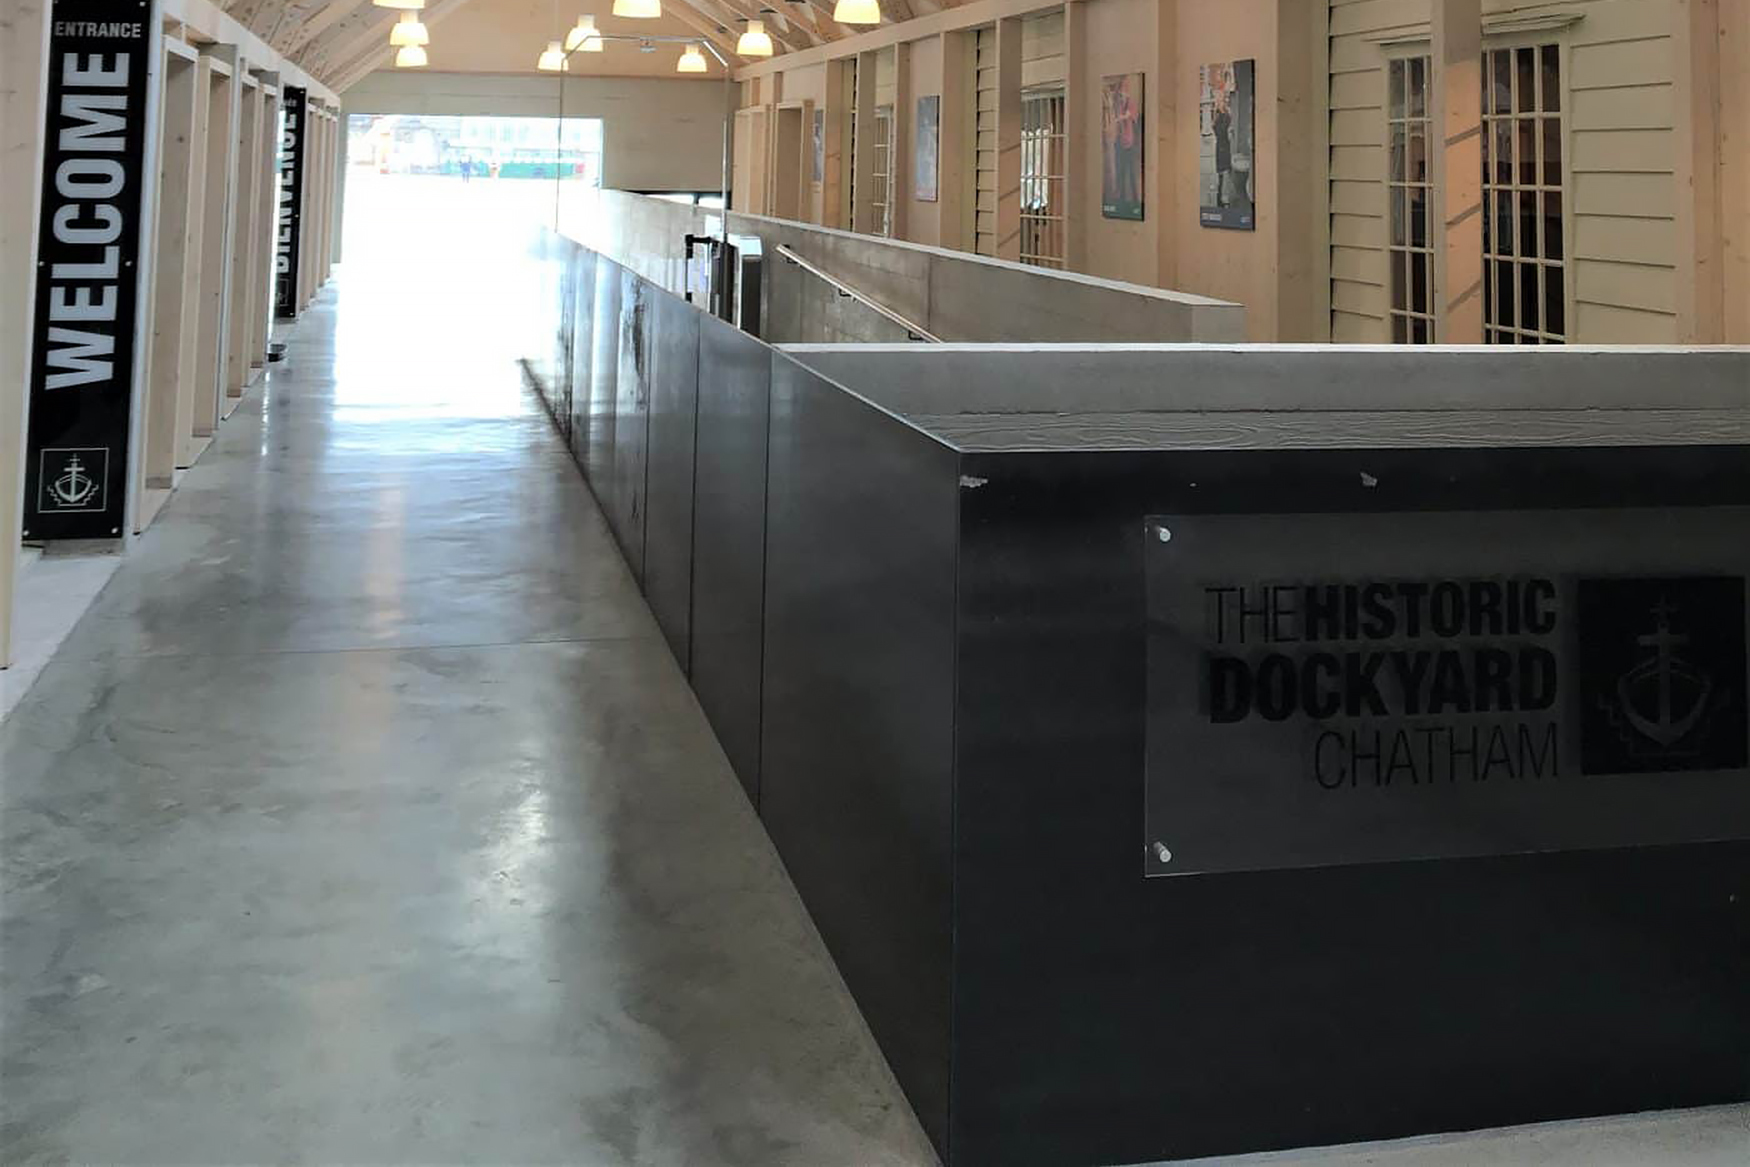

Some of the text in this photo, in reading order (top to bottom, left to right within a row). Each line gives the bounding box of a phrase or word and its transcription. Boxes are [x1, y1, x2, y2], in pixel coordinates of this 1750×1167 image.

[54, 21, 141, 38] ENTRANCE
[46, 52, 130, 391] WELCOME
[1204, 579, 1557, 644] THE HISTORIC
[1208, 646, 1558, 724] DOCKYARD
[1314, 723, 1560, 789] CHATHAM
